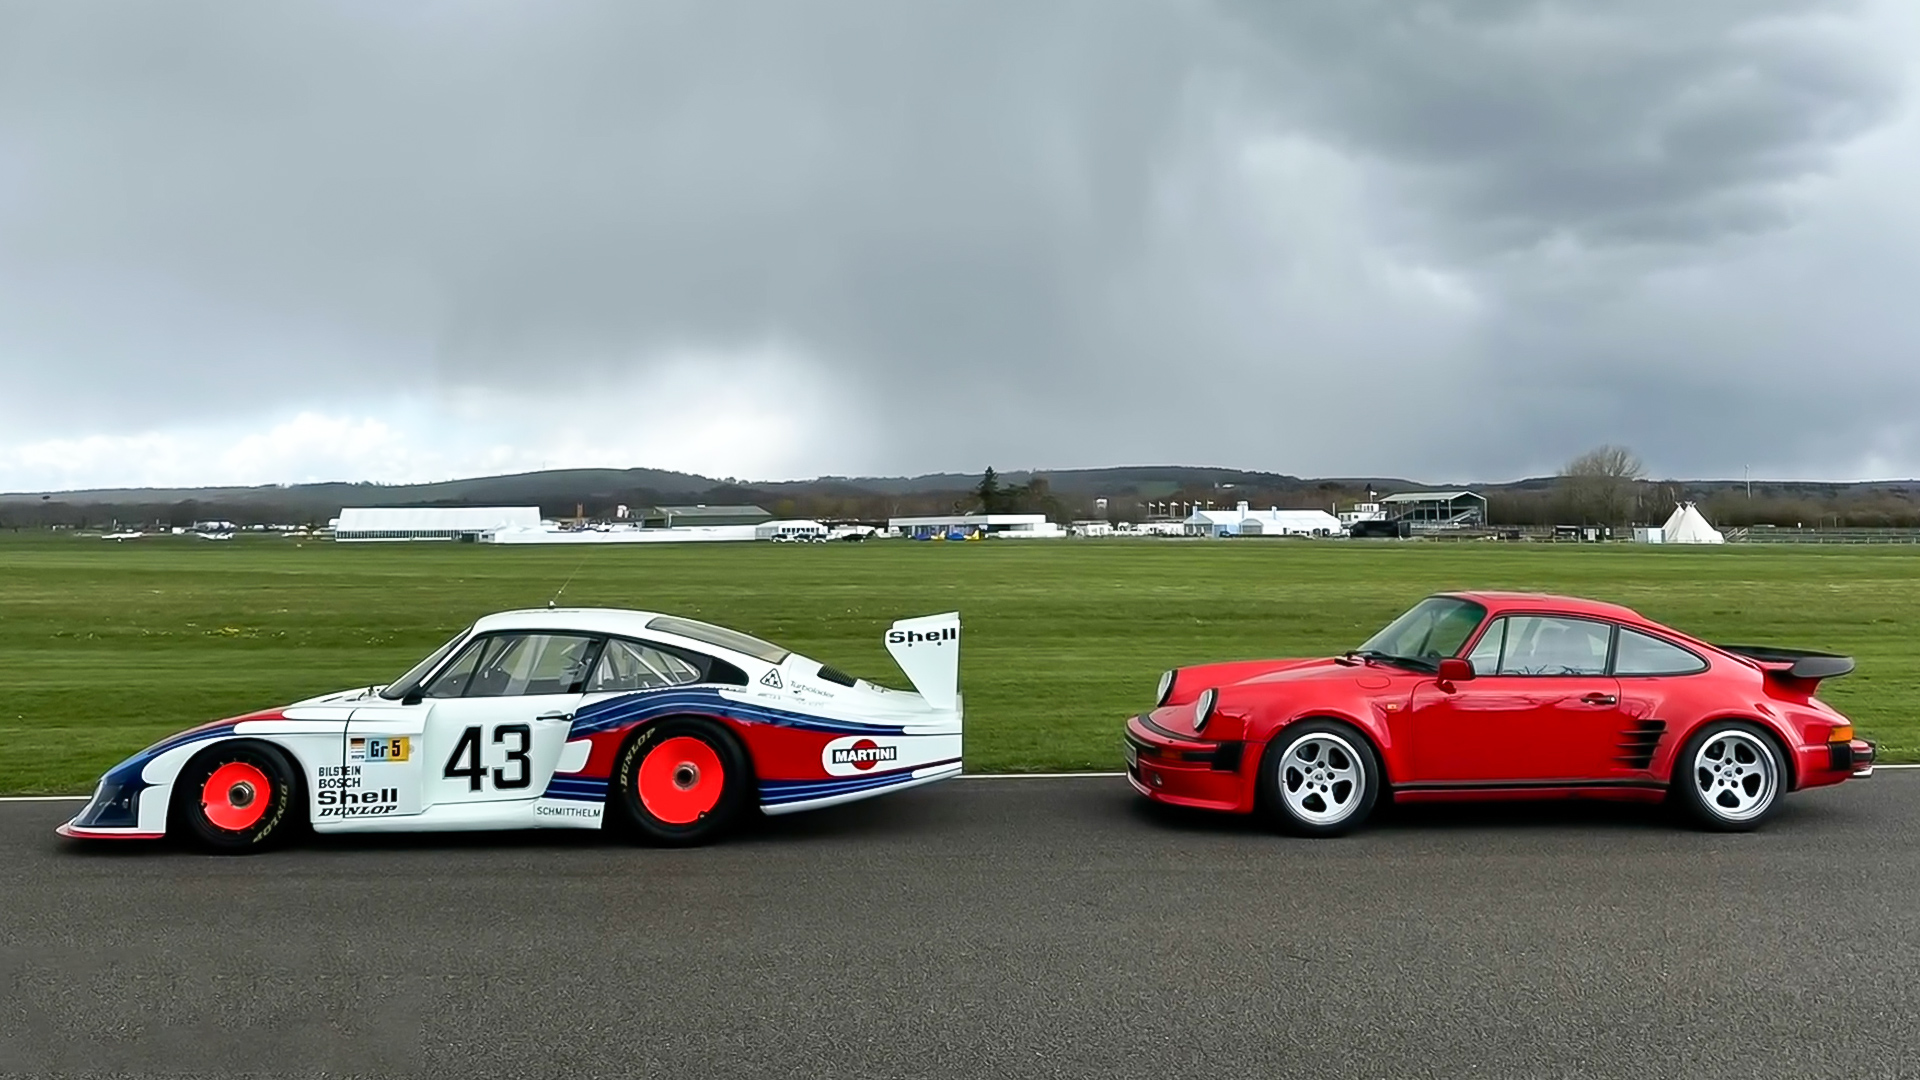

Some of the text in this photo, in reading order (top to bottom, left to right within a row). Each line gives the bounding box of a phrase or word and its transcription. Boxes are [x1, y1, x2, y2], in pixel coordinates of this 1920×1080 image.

[889, 628, 956, 643] Shell
[370, 740, 401, 757] Gr 5
[835, 748, 895, 762] MARTINI
[443, 724, 531, 791] 43
[620, 727, 656, 787] DUNLOP
[318, 766, 361, 777] BILSTEIN
[318, 778, 361, 789] BOSCH
[318, 788, 397, 805] Shell
[252, 784, 288, 843] DUNLOP
[318, 805, 397, 817] DUNLOP
[536, 806, 601, 818] SCHMITTHELM
